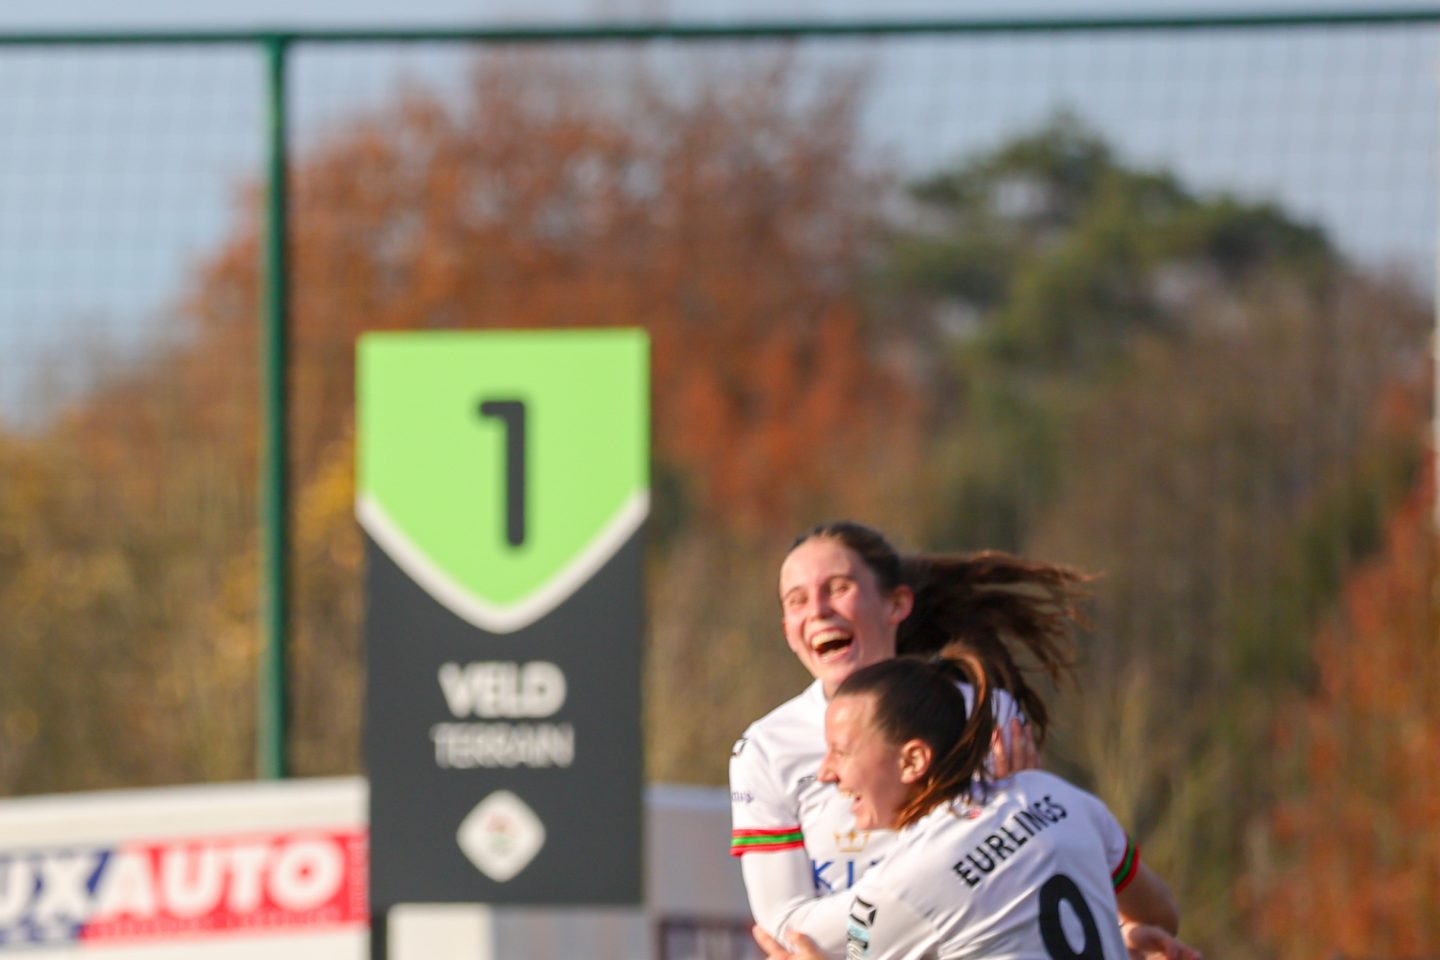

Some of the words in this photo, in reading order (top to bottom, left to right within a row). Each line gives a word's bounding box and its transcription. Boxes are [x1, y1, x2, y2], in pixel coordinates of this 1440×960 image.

[478, 400, 525, 546] 1
[438, 661, 568, 719] VELD
[812, 858, 884, 892] KI
[953, 796, 1069, 890] EURLINGS
